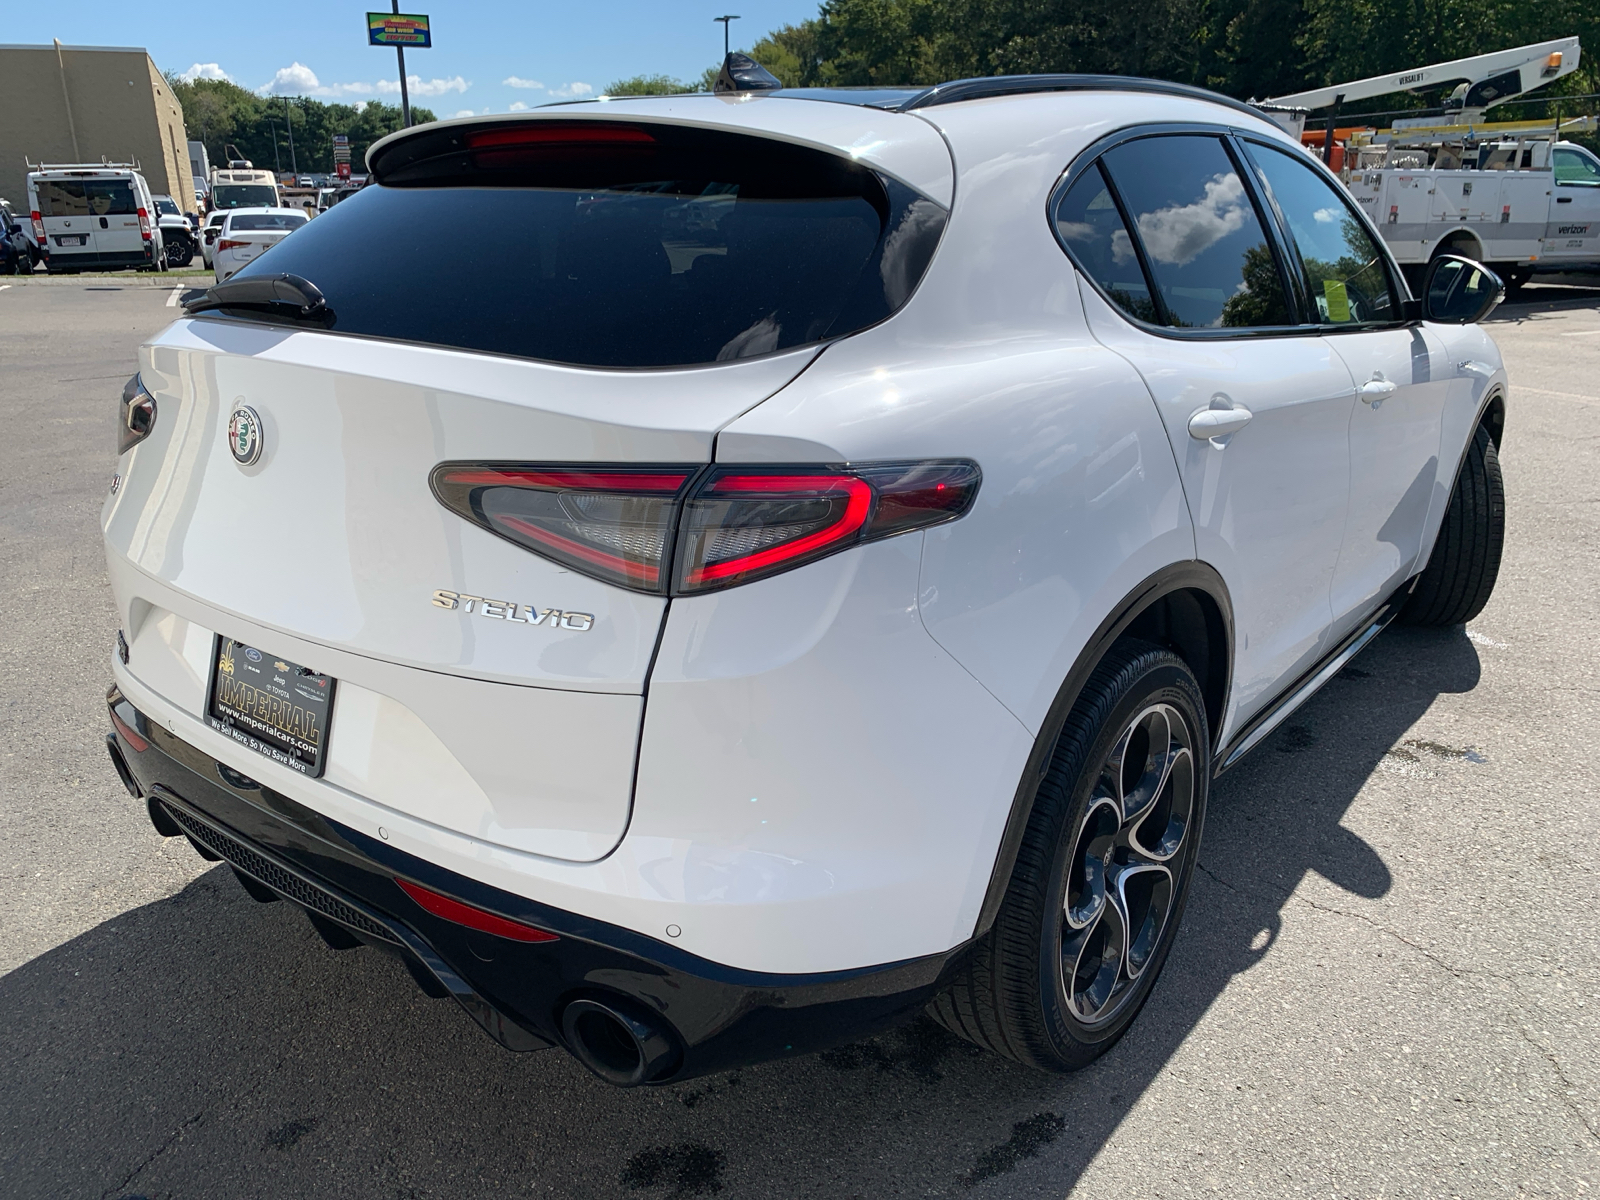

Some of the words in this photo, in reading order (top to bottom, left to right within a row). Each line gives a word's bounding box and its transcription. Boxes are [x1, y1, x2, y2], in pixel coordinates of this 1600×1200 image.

[1398, 72, 1424, 86] VERSALIFT
[1558, 223, 1588, 235] verizon
[431, 588, 596, 632] STELVIO
[273, 674, 286, 687] Jeep
[271, 685, 290, 699] TOYOTA
[296, 682, 325, 698] CHRYSLER
[219, 673, 320, 745] IMPERIAL
[218, 703, 318, 755] www.imperialcars.com
[211, 719, 221, 730] We
[232, 729, 249, 746] More,
[249, 738, 258, 750] So
[259, 742, 271, 756] You
[271, 749, 288, 764] Save
[288, 757, 306, 773] More
